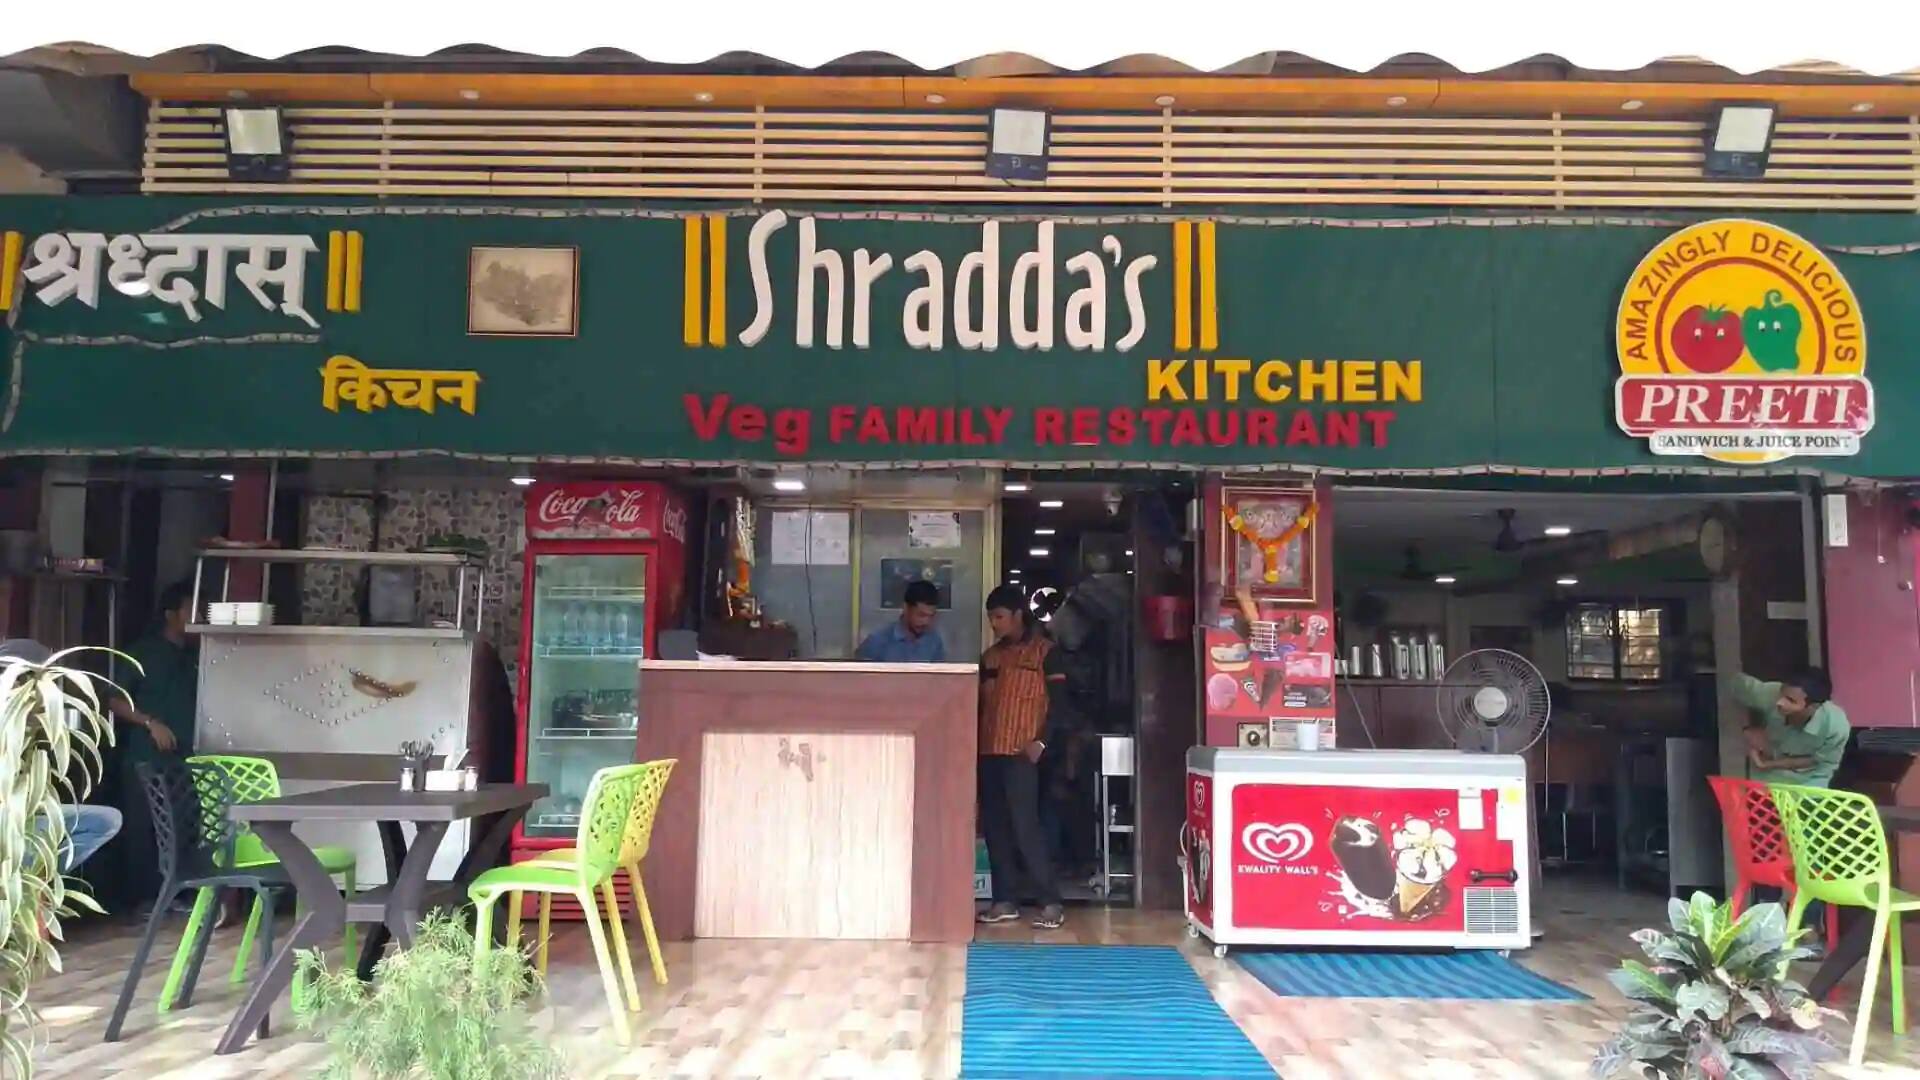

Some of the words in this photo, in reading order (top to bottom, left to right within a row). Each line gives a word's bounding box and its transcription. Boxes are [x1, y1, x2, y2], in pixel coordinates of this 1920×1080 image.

[738, 208, 1158, 352] Shradda's
[1625, 229, 1731, 361] AMAZINGLY
[1750, 231, 1858, 362] DELICIOUS
[320, 355, 481, 415] किचन
[1147, 359, 1423, 403] KITCHEN
[1634, 384, 1854, 425] PREETI
[682, 393, 813, 456] Veg
[829, 404, 1014, 445] FAMILY
[1033, 406, 1397, 448] RESTAURANT
[1657, 435, 1740, 449] SANDWICH
[1743, 435, 1754, 449] &
[1756, 435, 1802, 450] JUICE
[1804, 435, 1852, 449] POINT
